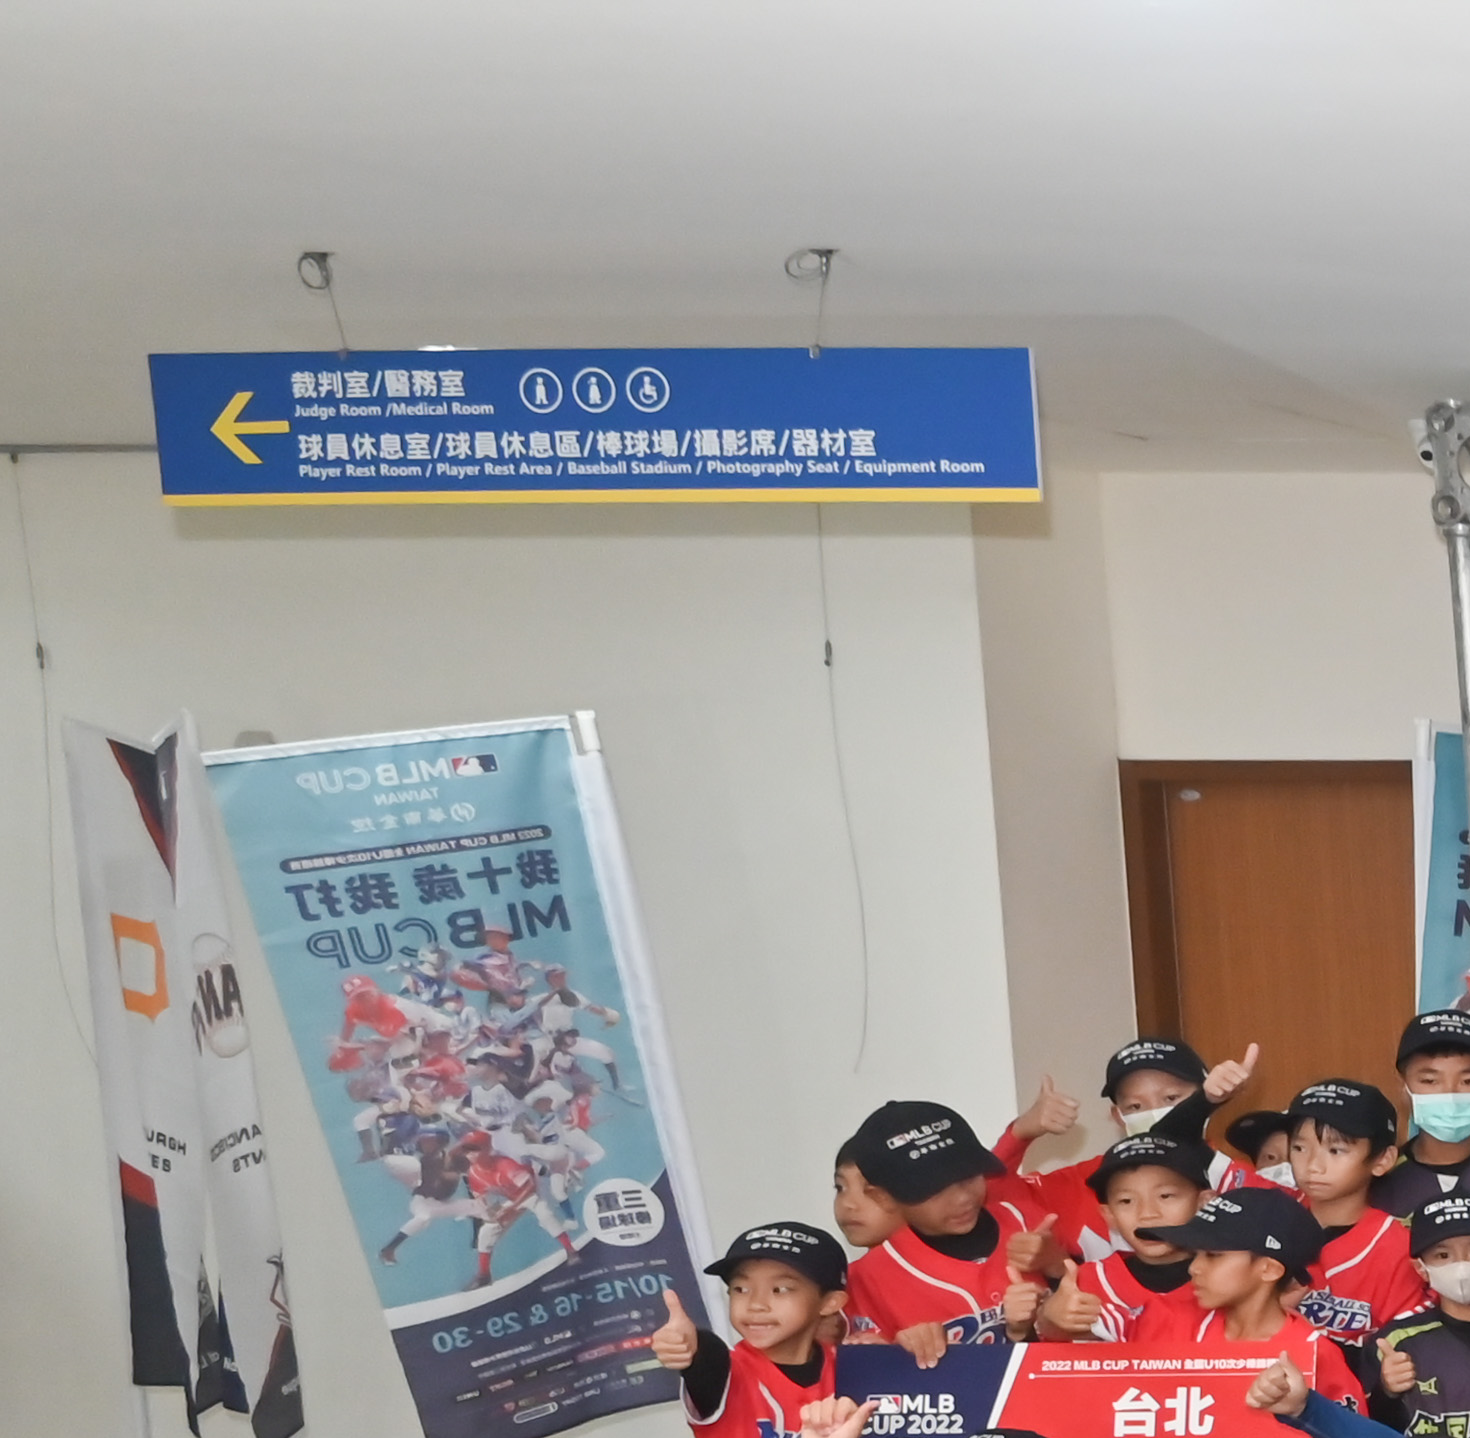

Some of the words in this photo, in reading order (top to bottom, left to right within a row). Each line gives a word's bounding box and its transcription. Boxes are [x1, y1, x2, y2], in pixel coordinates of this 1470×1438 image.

[290, 369, 466, 399] 裁判室/醫務室
[295, 404, 336, 420] Judge
[341, 403, 382, 417] Room
[386, 402, 447, 416] /Medical
[453, 402, 494, 416] Room
[299, 464, 341, 481] Player
[345, 463, 376, 477] Rest
[380, 463, 422, 477] Room
[437, 463, 480, 480] Player
[485, 462, 516, 476] Rest
[520, 462, 552, 475] Area
[568, 461, 626, 475] Baseball
[631, 460, 692, 474] Stadium
[707, 460, 802, 477] Photography
[807, 460, 839, 474] Seat
[855, 460, 936, 476] Equipment
[940, 459, 985, 473] Room
[1112, 1386, 1216, 1438] 台北
